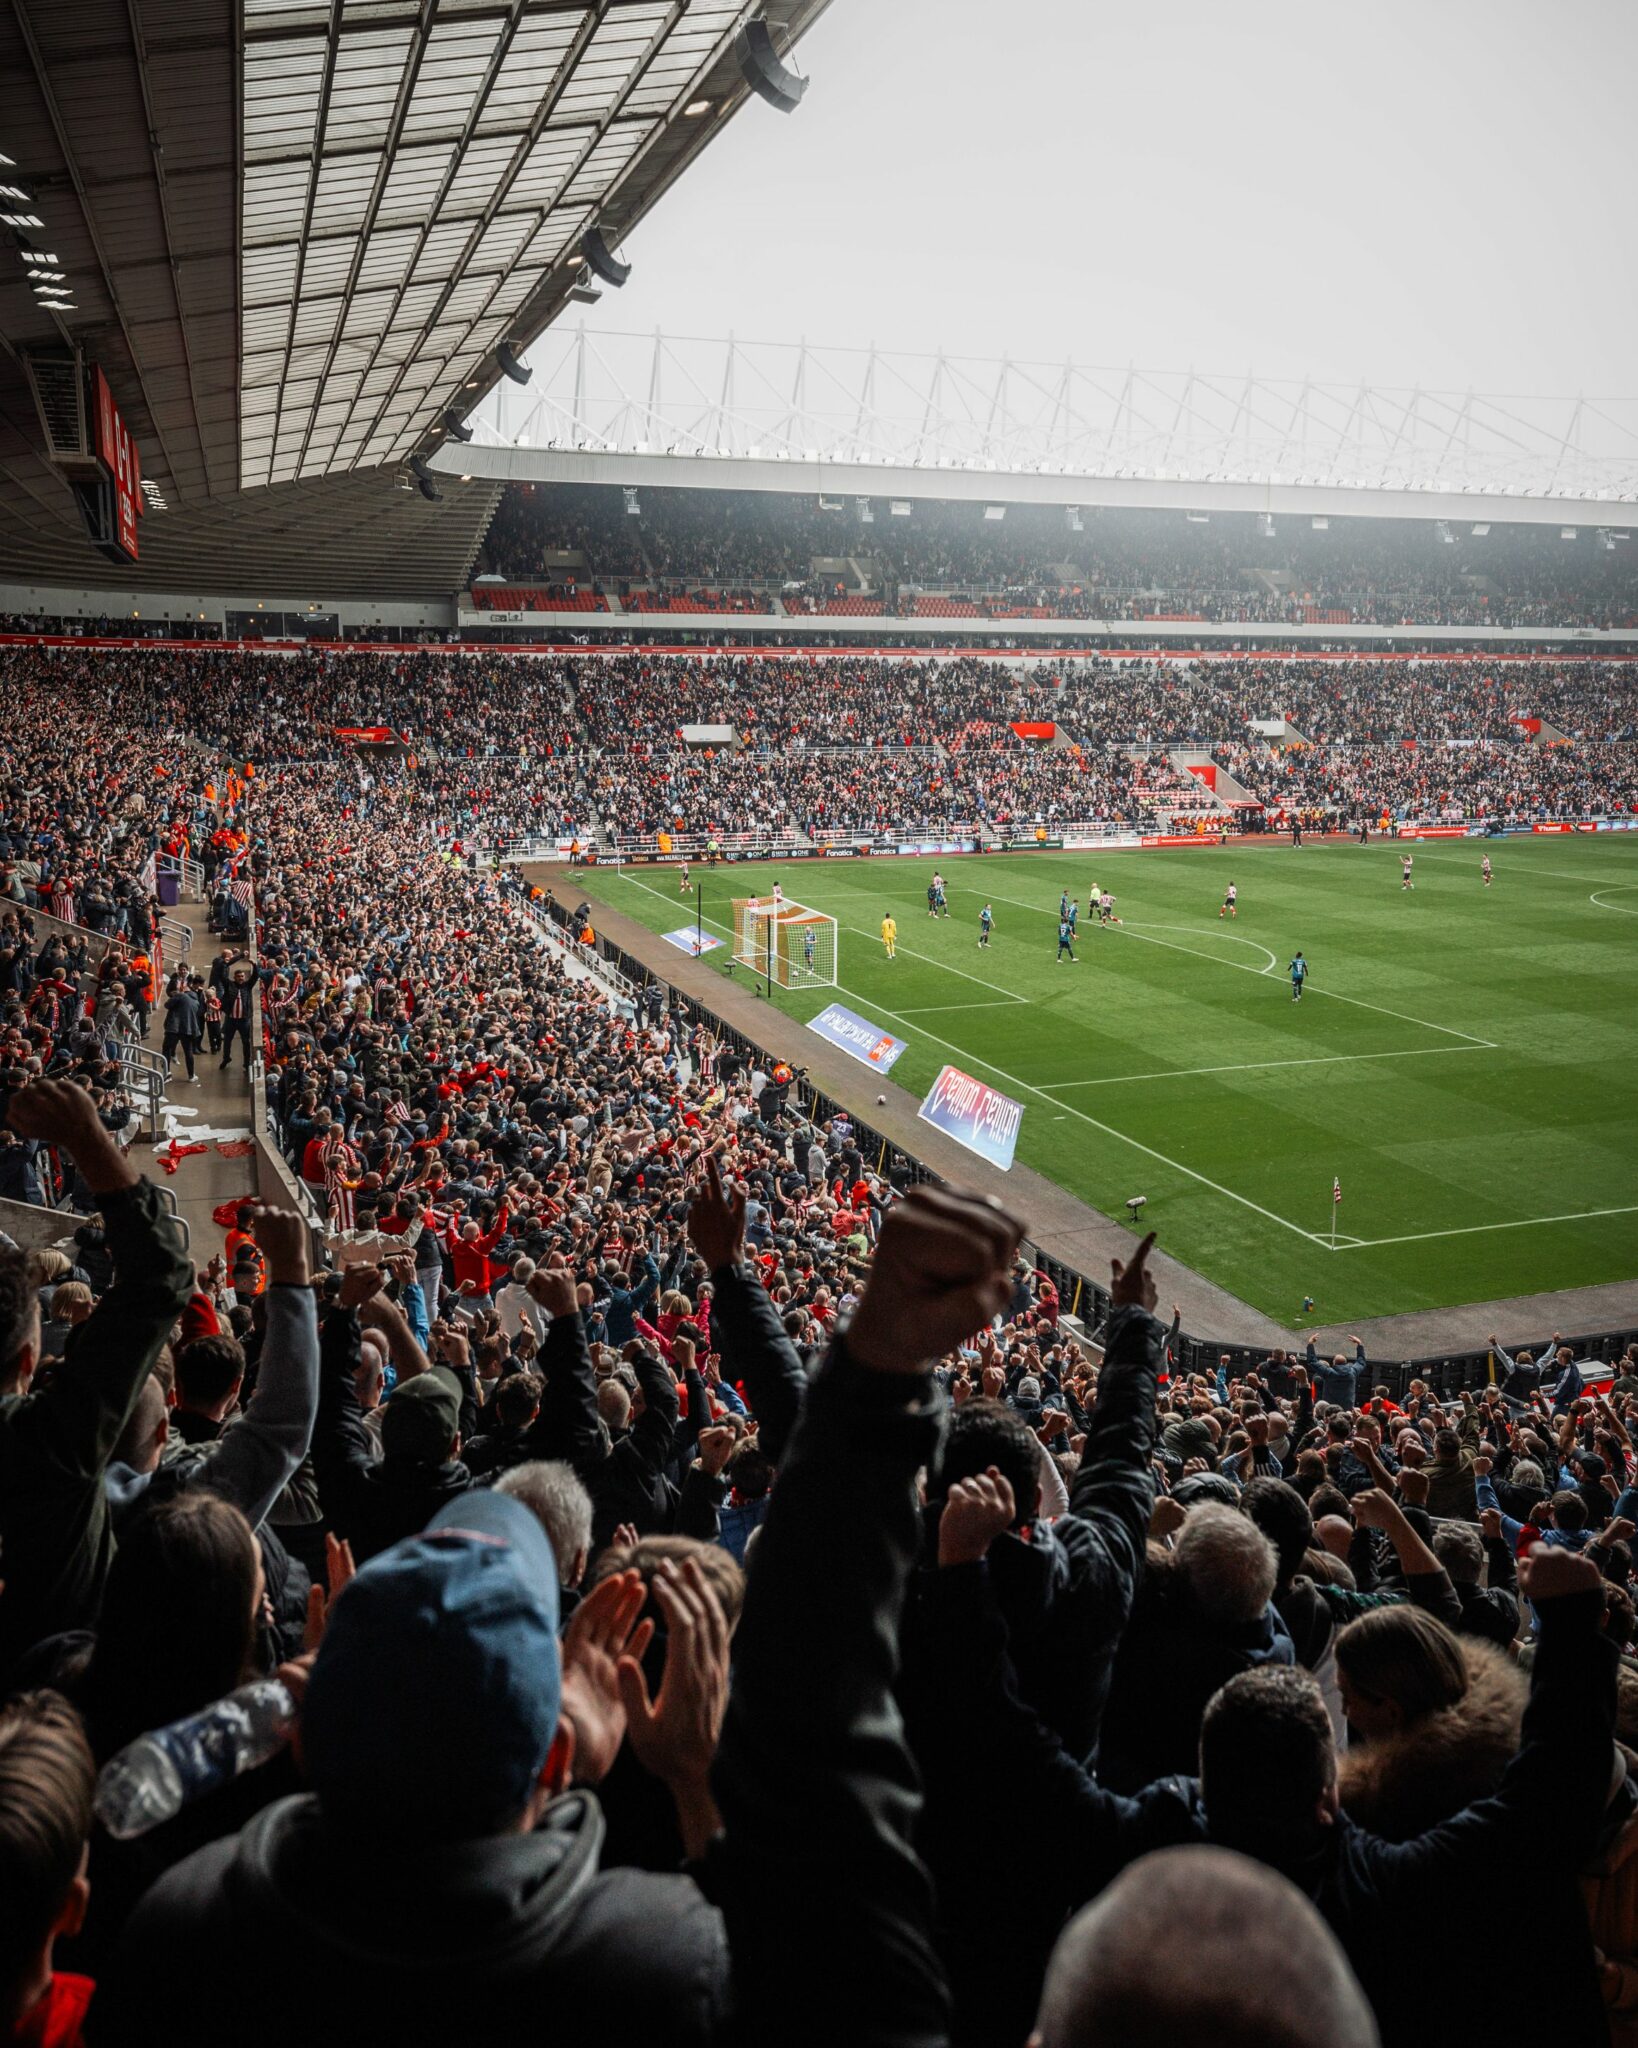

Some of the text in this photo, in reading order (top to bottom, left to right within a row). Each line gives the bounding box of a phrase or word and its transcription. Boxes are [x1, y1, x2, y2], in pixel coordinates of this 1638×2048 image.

[826, 849, 853, 857] Fanatics
[870, 847, 896, 855] Fanatics
[596, 857, 626, 865] Fanatics
[945, 1074, 1020, 1145] utilita utilita
[836, 1122, 847, 1133] 23
